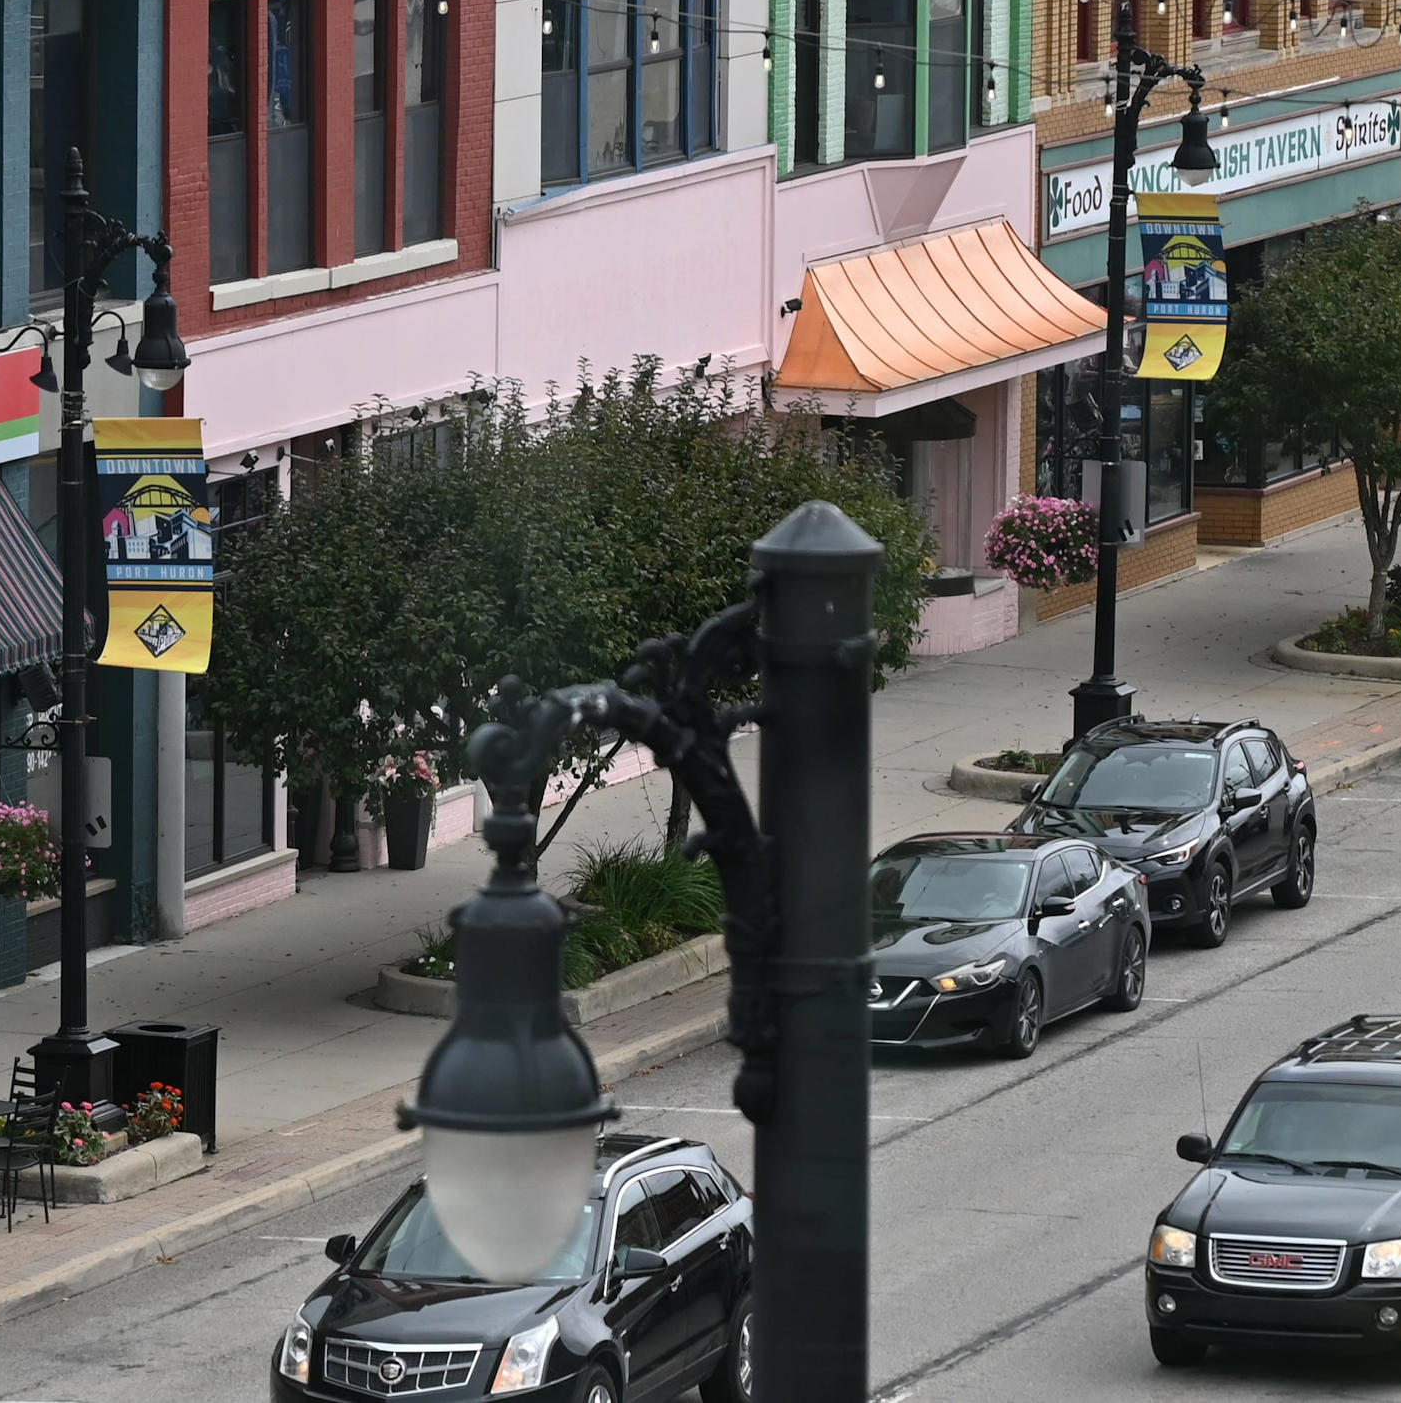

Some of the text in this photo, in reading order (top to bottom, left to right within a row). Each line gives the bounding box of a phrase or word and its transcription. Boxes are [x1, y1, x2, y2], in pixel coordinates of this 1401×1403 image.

[1063, 175, 1103, 219] Food
[1255, 125, 1321, 172] TAVERN
[1146, 223, 1215, 235] DOWNTOWN
[1153, 303, 1223, 316] PORT HURON
[105, 459, 198, 474] DOWNTOWN
[116, 565, 205, 579] PORT HURON
[1249, 1253, 1303, 1270] GMC
